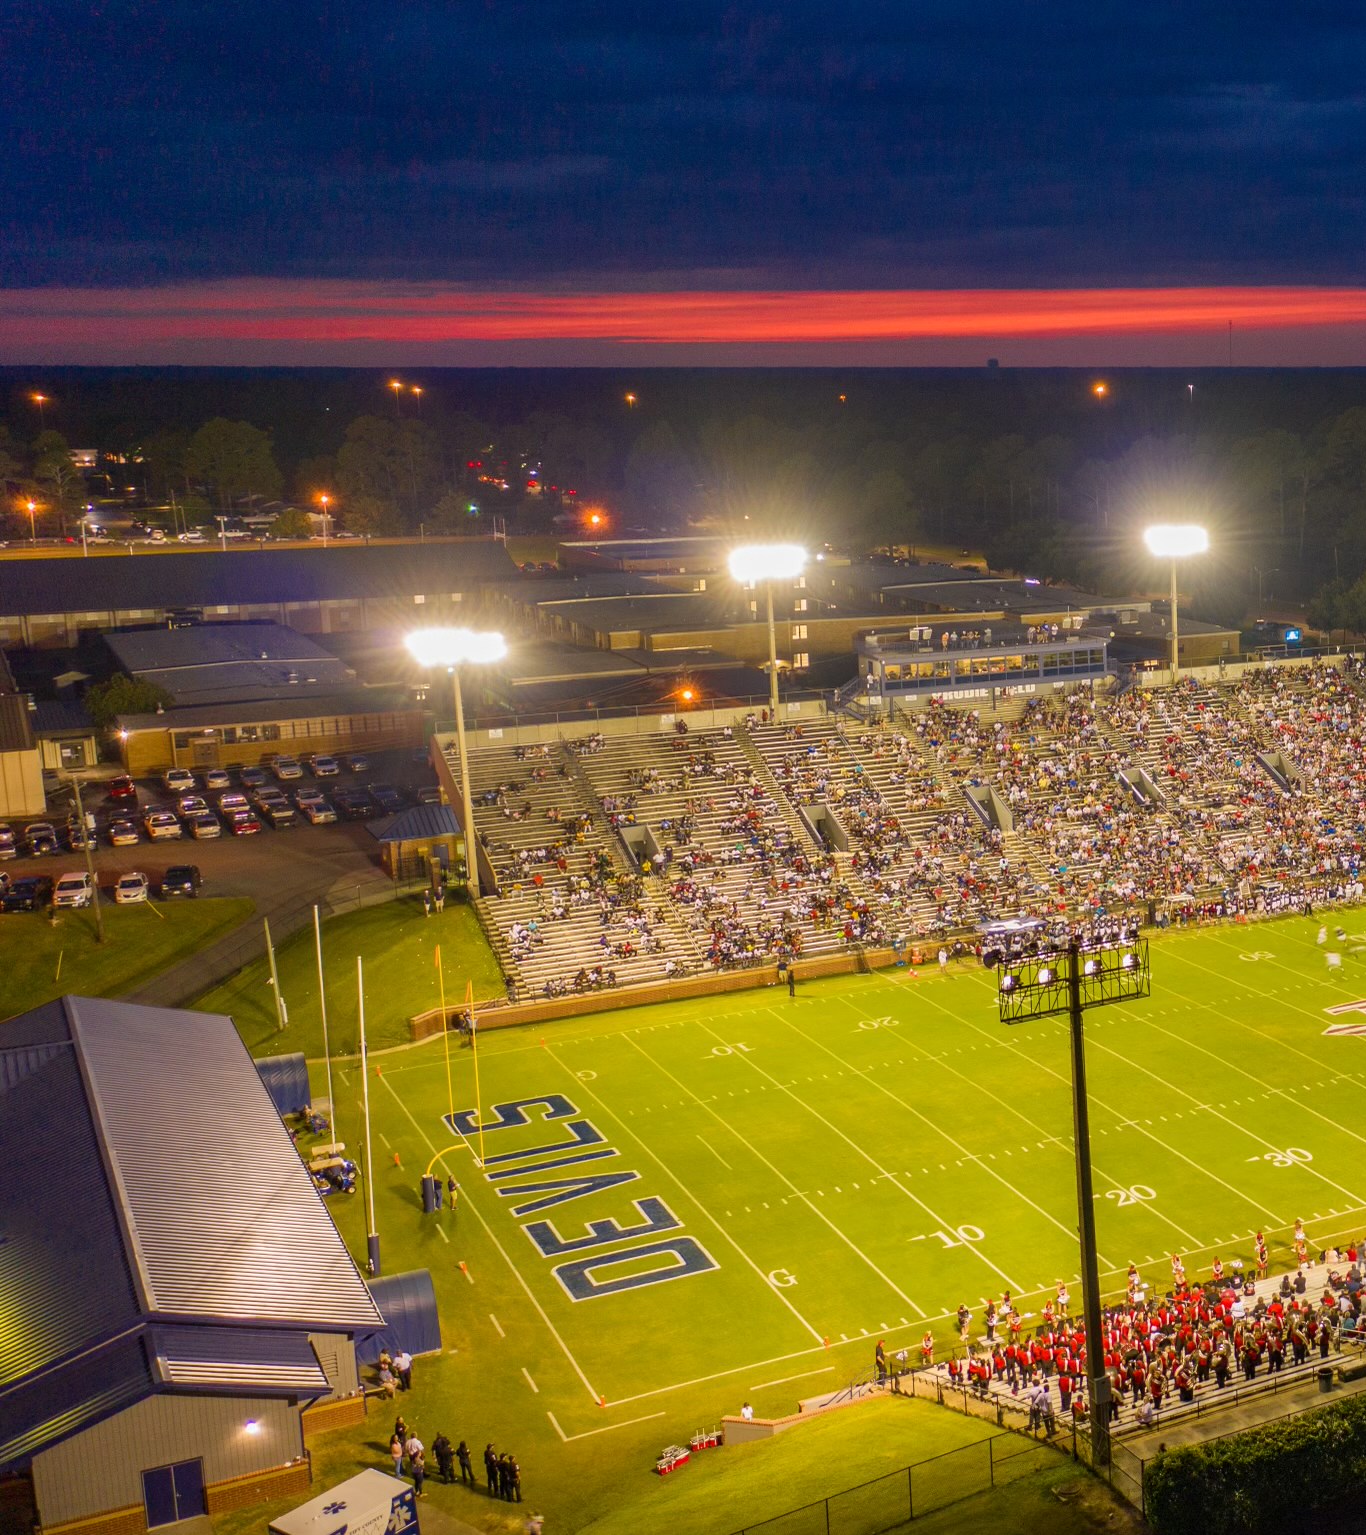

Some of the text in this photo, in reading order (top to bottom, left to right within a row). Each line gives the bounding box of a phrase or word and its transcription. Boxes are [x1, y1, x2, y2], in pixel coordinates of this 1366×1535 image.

[1238, 951, 1277, 962] 50
[858, 1015, 900, 1030] 20
[711, 1041, 757, 1056] 10
[1262, 1146, 1314, 1168] 30
[441, 1093, 722, 1303] DEVILS
[1104, 1183, 1158, 1208] 20
[923, 1223, 987, 1249] 10
[767, 1268, 800, 1288] G
[362, 1514, 384, 1529] COUNTY
